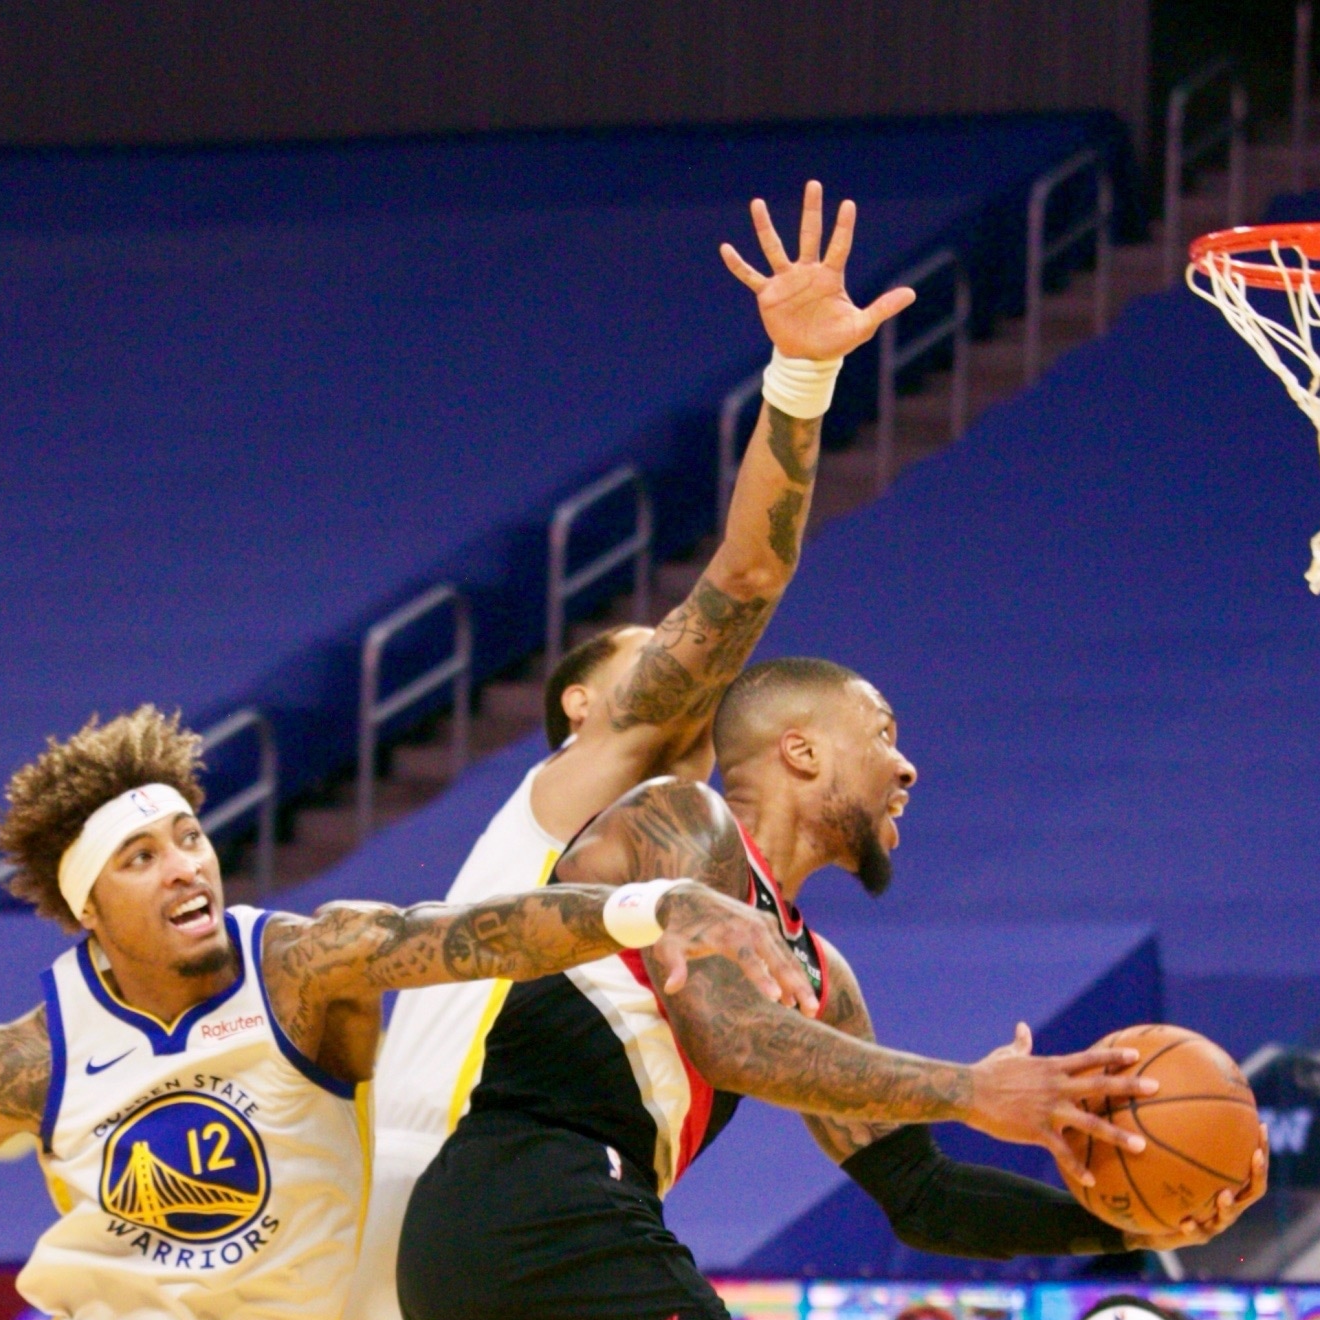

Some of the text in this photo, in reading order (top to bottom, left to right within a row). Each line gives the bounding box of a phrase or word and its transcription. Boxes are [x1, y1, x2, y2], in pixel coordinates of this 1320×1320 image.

[200, 1013, 265, 1041] Rakuten
[194, 1074, 259, 1118] STATE
[187, 1122, 236, 1175] 12
[106, 1214, 279, 1269] WARRIORS
